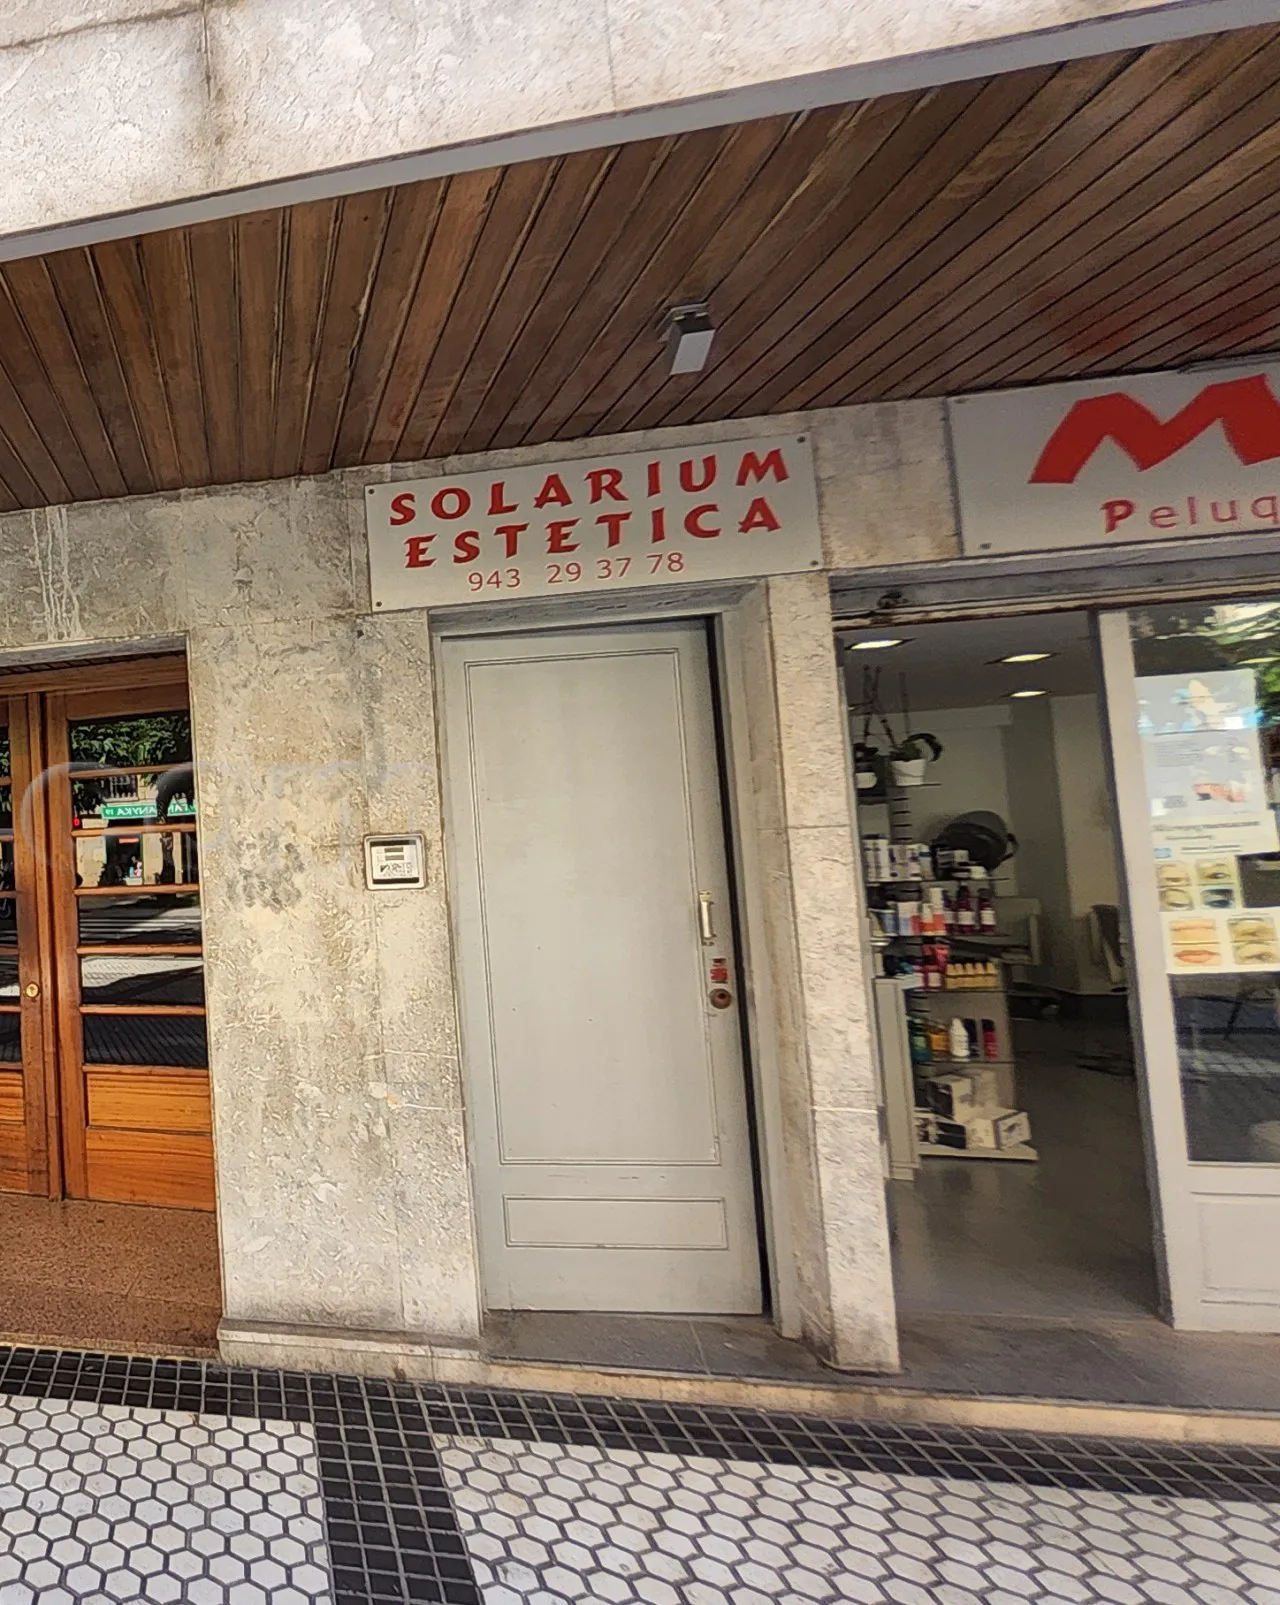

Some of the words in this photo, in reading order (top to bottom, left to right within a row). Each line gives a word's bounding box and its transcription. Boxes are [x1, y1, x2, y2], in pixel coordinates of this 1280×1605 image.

[389, 448, 790, 526] SOLARIUM
[404, 497, 781, 569] ESTETICA
[468, 568, 521, 592] 943
[547, 563, 582, 584] 29
[596, 557, 632, 579] 37
[646, 552, 685, 573] 78
